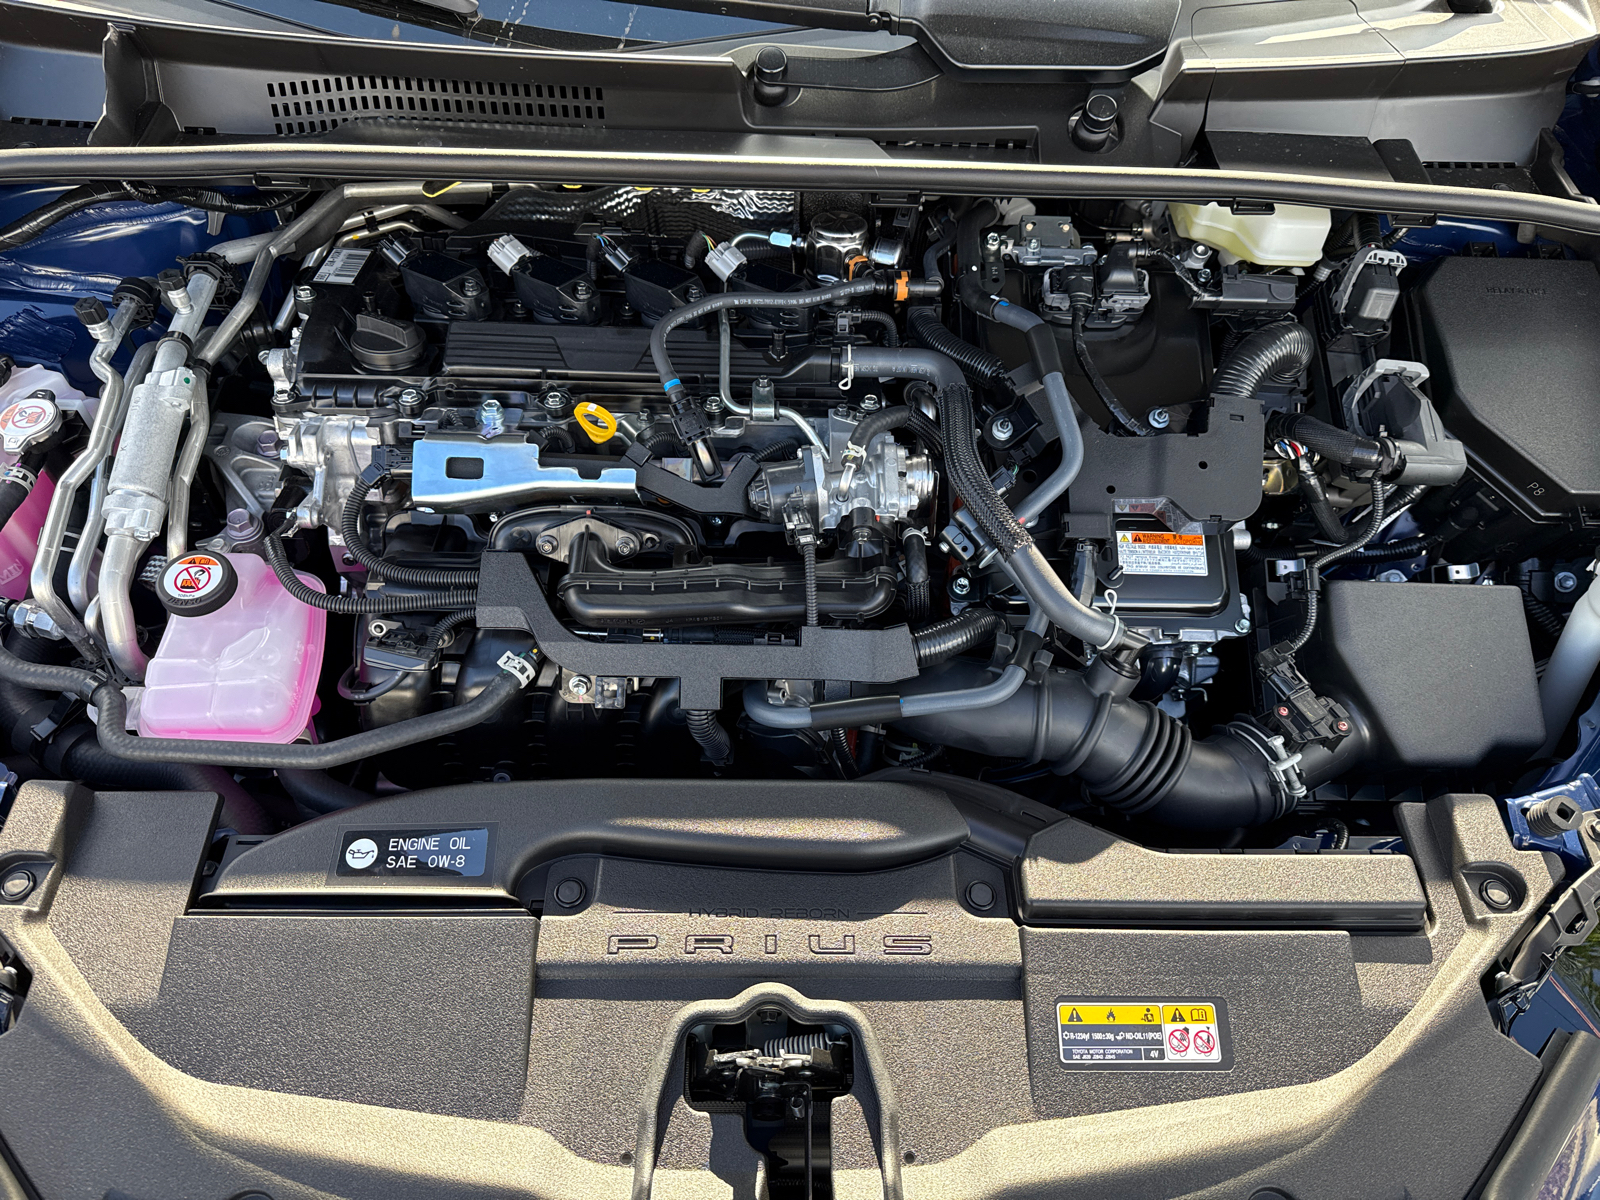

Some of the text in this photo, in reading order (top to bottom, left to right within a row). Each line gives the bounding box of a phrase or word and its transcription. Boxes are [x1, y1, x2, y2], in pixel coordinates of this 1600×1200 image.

[1526, 481, 1545, 496] P8
[167, 597, 203, 606] DENSO
[388, 837, 471, 851] ENGINE OIL
[385, 855, 466, 868] SAE 0W-8
[688, 907, 850, 919] HYBRID REBORN
[606, 934, 933, 955] PRIUS
[1149, 1050, 1159, 1058] 4V
